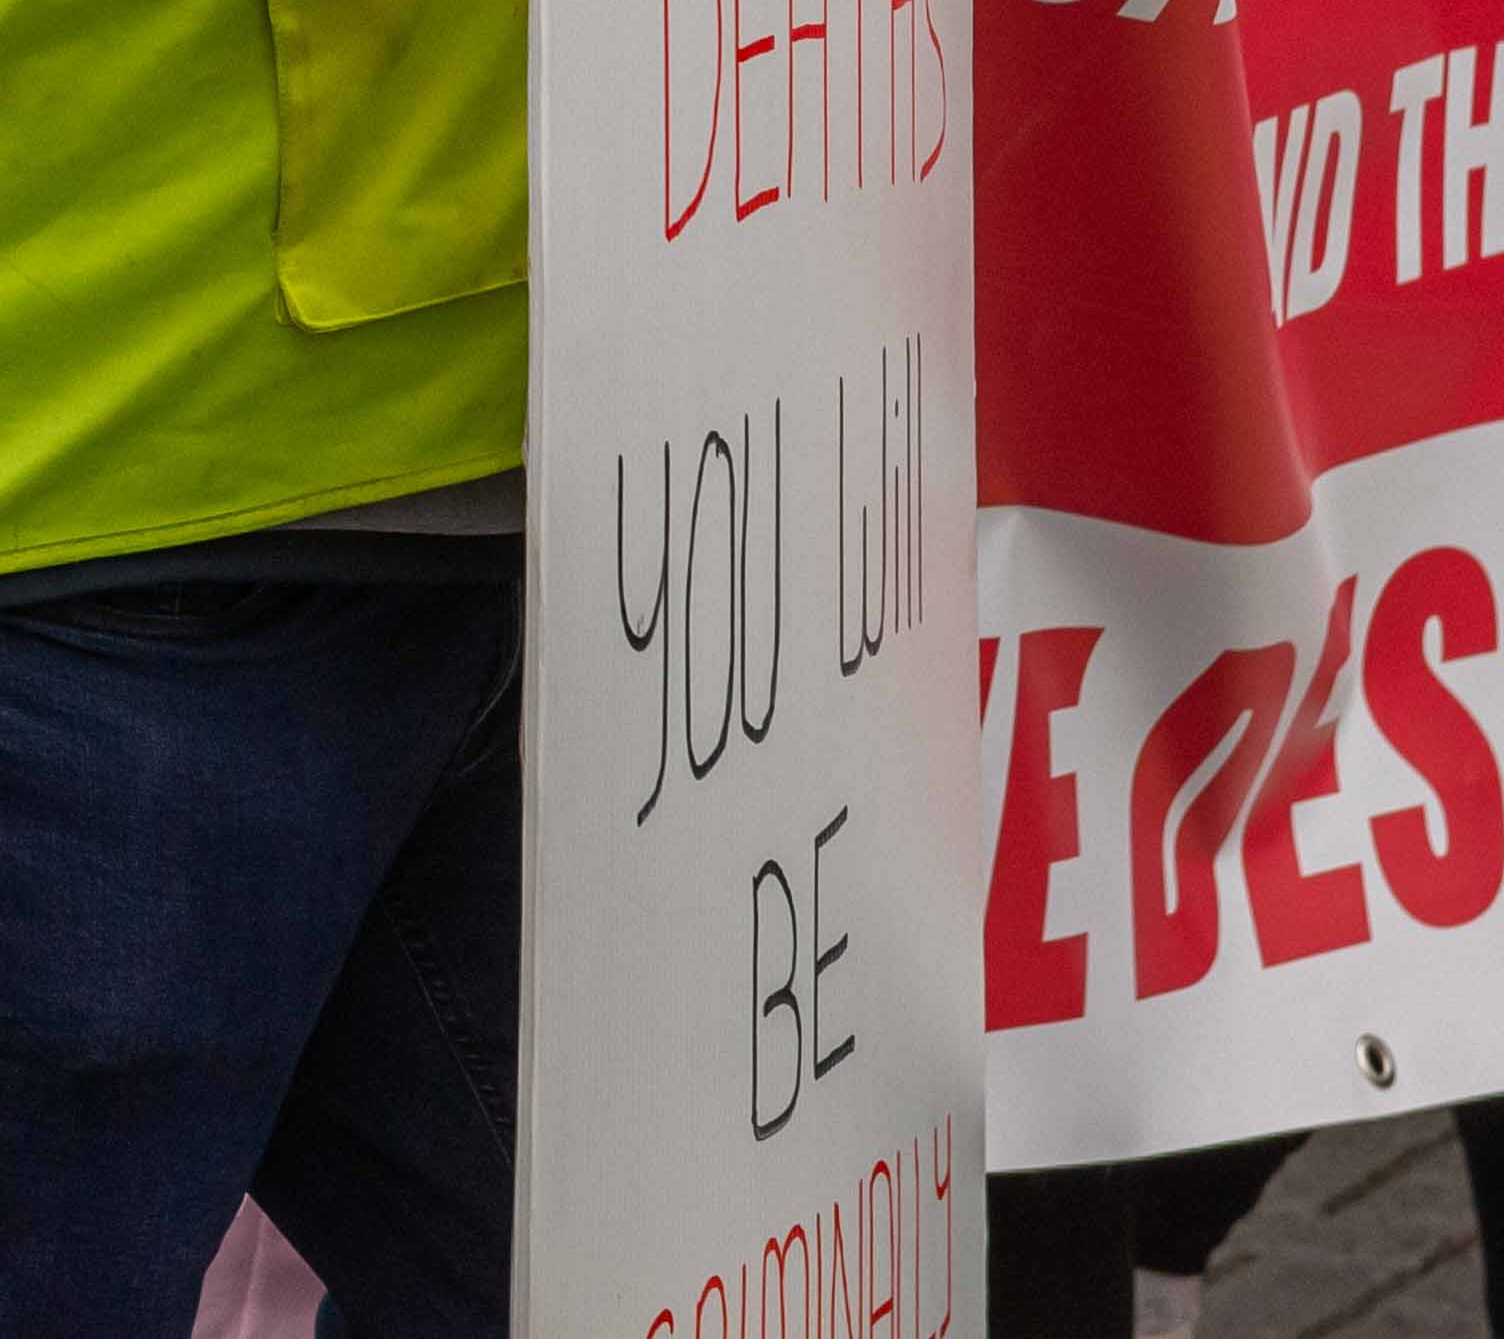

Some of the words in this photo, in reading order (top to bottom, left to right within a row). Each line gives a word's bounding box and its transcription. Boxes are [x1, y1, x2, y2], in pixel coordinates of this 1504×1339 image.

[1252, 88, 1363, 330] ND
[618, 397, 782, 827] YOU
[751, 805, 857, 1142] BE
[979, 626, 1105, 1034] E
